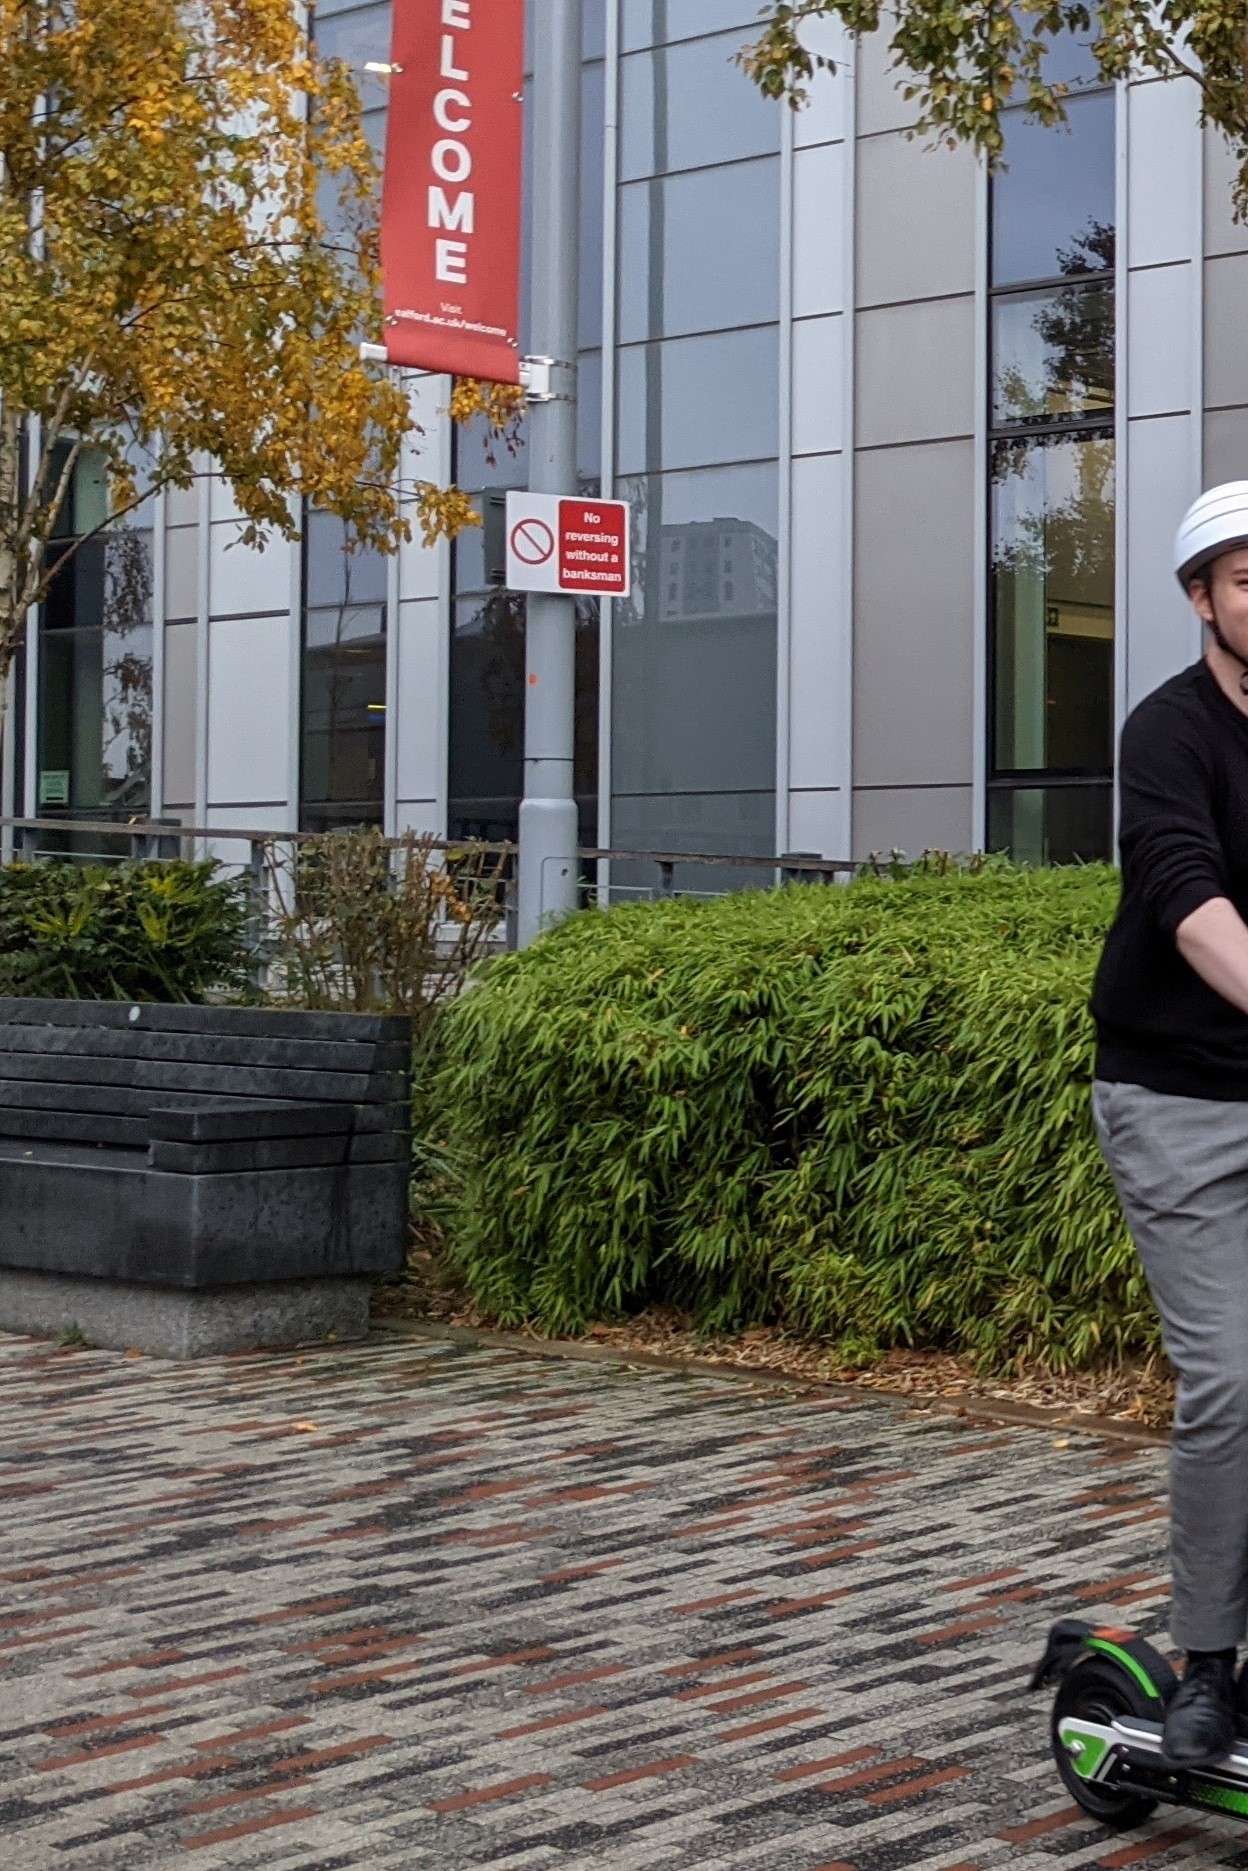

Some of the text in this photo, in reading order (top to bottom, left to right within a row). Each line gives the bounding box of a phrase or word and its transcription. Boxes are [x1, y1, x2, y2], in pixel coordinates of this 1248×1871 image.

[583, 512, 601, 524] No
[565, 531, 619, 546] reversing
[565, 550, 618, 563] without a
[562, 568, 622, 582] banksman
